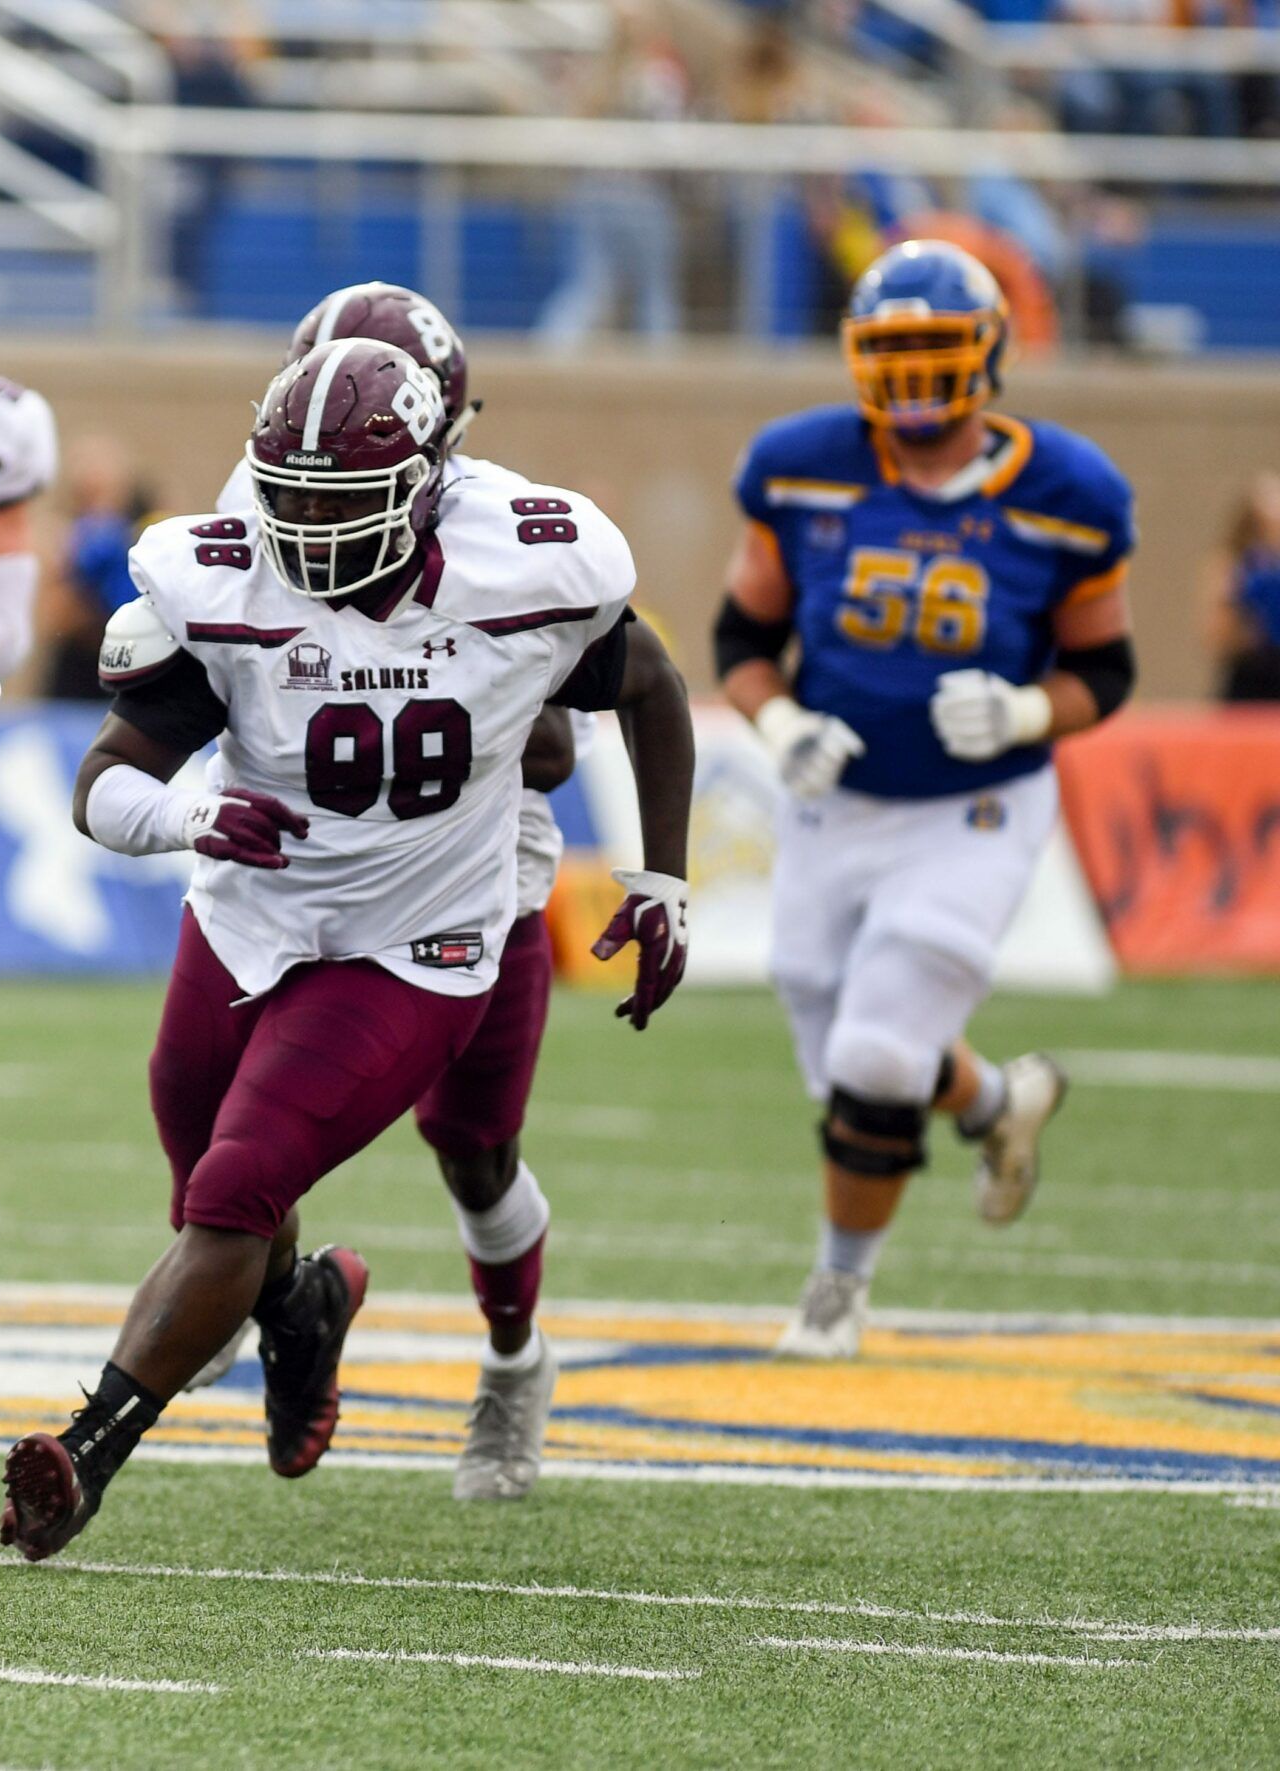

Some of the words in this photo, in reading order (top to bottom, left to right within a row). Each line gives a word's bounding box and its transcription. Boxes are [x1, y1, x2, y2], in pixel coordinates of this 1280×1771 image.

[286, 454, 332, 467] Riddell
[187, 517, 252, 571] 88
[510, 497, 578, 545] 88
[836, 546, 990, 656] 56
[341, 668, 429, 692] SALUKIS
